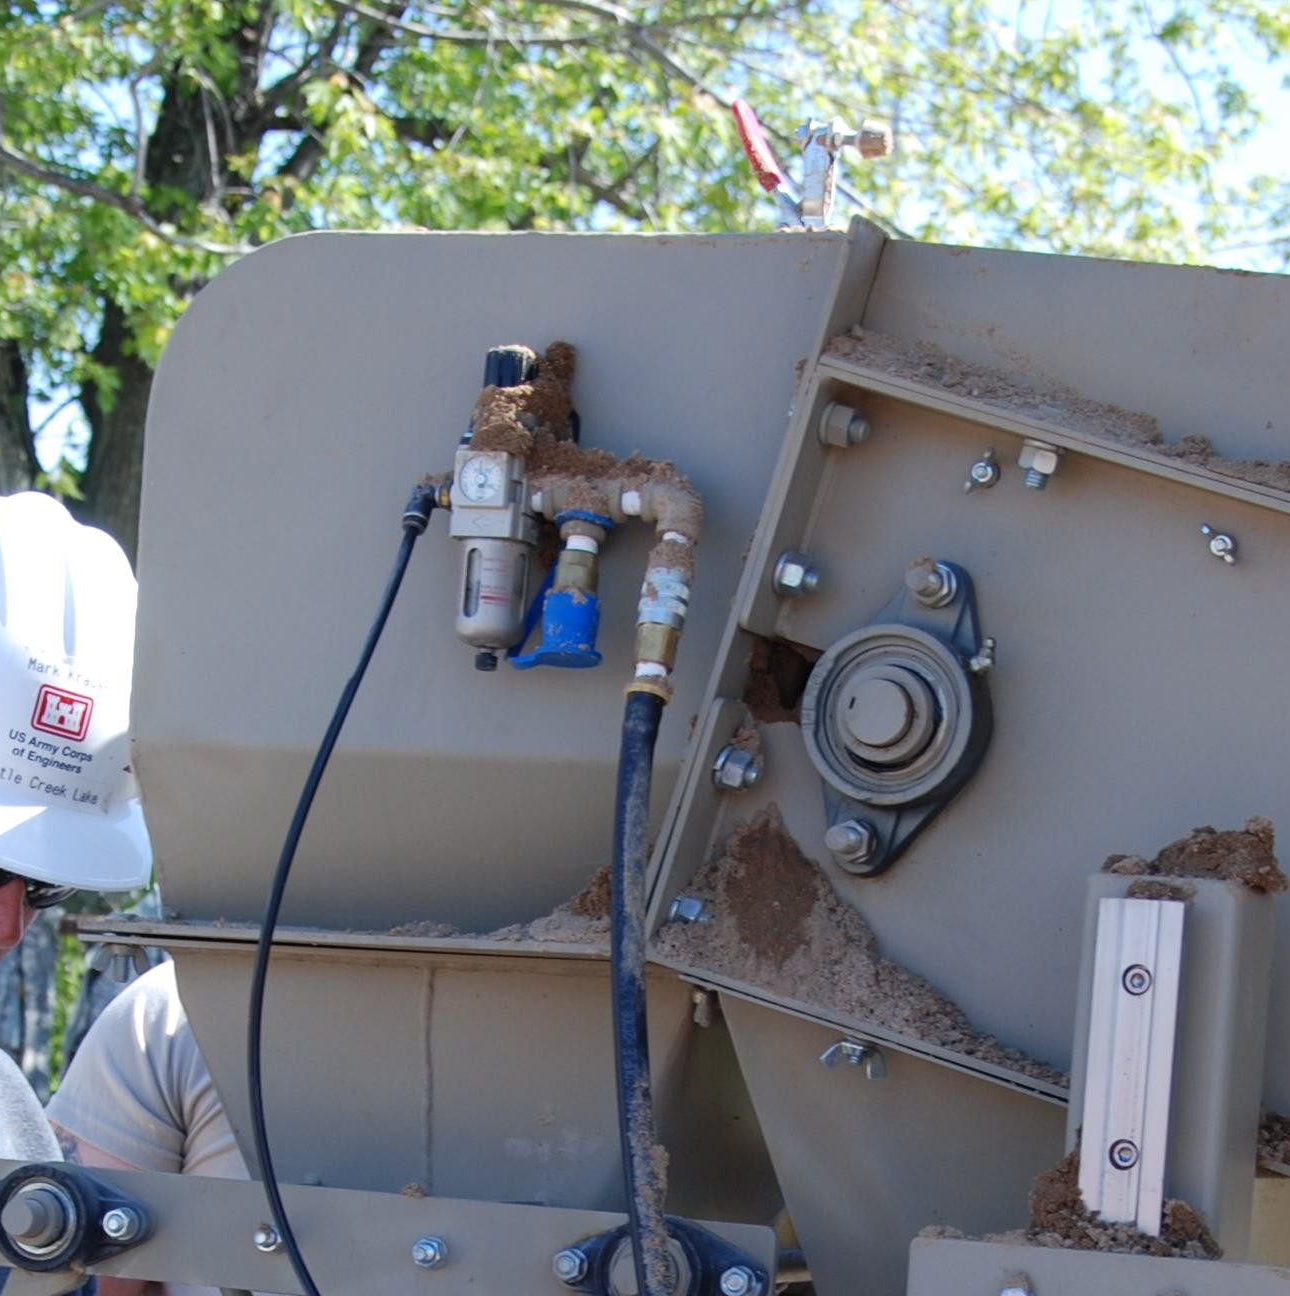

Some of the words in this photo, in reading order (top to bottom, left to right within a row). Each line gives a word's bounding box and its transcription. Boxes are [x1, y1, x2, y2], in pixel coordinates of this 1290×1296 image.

[27, 657, 60, 677] Mark
[9, 729, 26, 743] US
[28, 736, 60, 755] Army
[62, 746, 93, 762] Corps
[12, 747, 25, 757] of
[27, 750, 82, 774] Engineers
[29, 776, 67, 797] Creek
[72, 788, 99, 805] Lake
